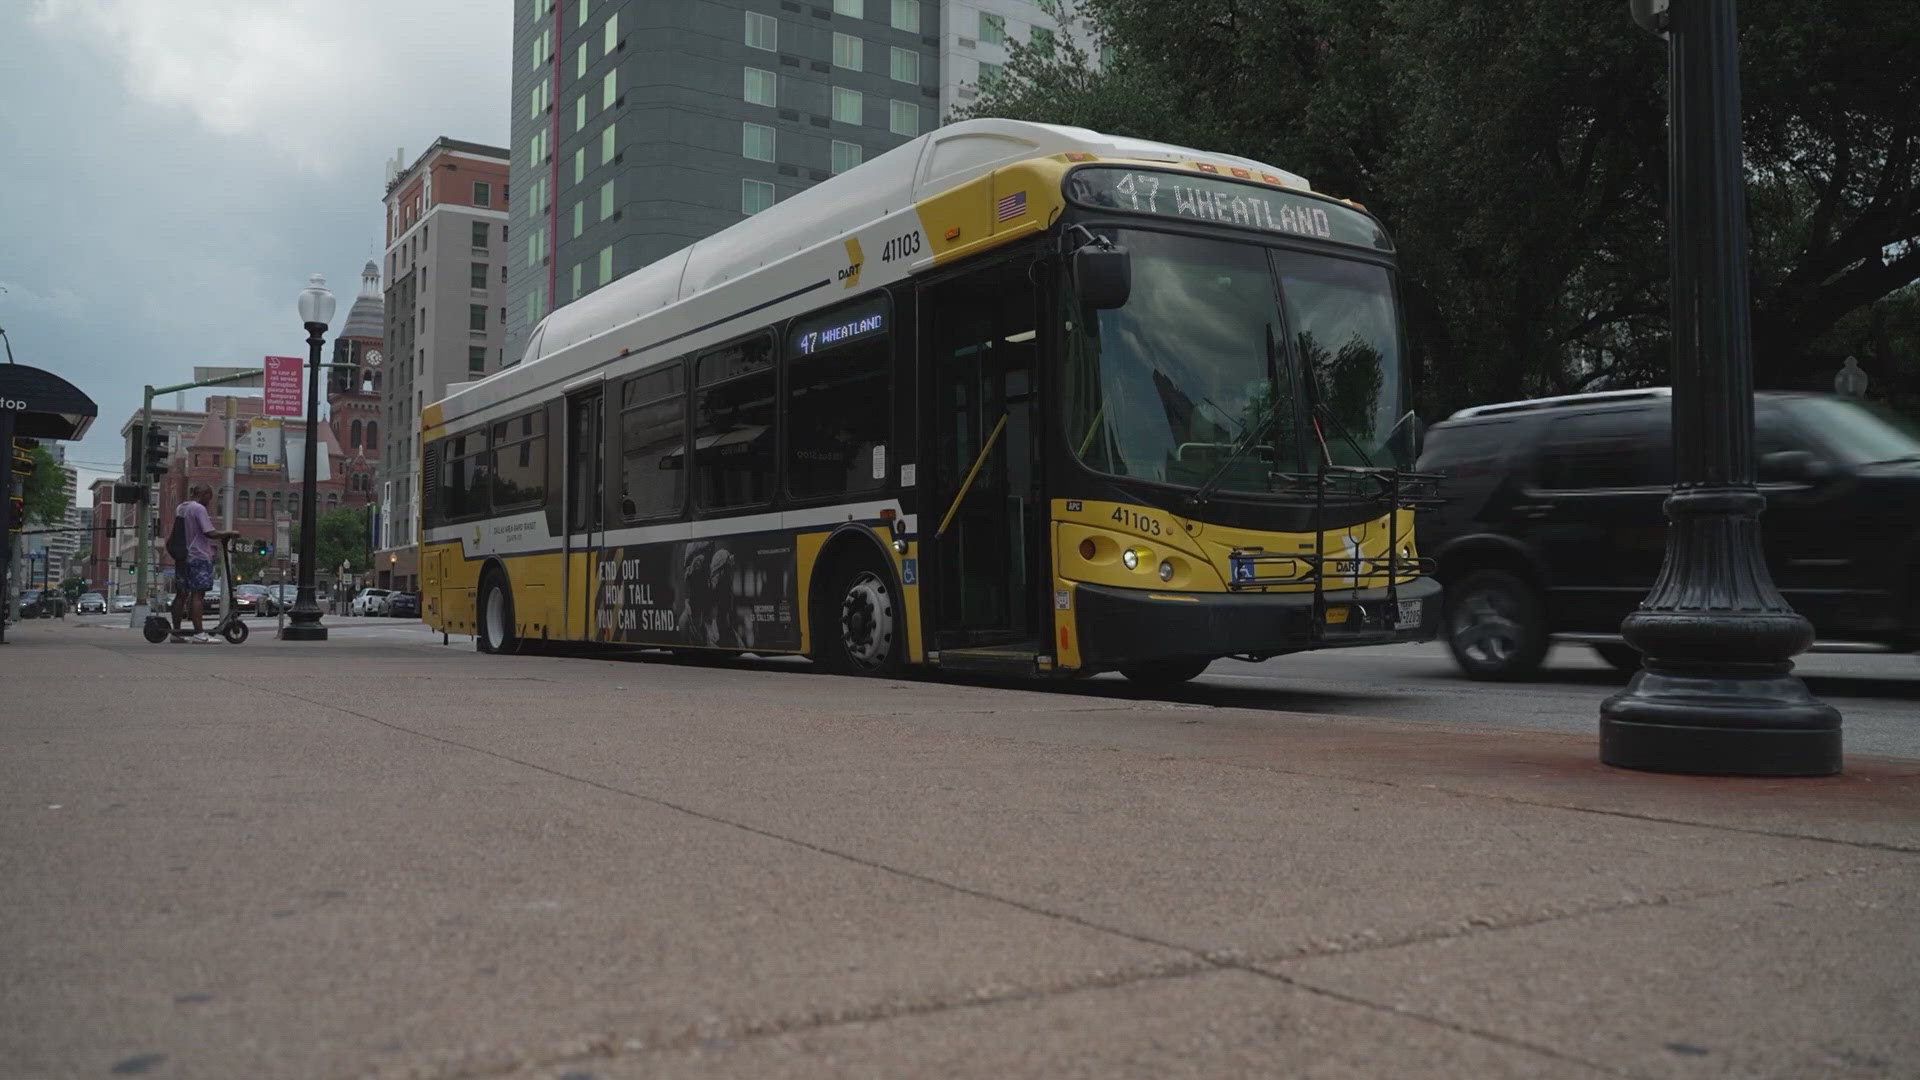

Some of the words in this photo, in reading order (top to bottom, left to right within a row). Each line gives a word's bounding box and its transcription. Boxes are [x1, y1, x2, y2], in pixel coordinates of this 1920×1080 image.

[1116, 173, 1160, 213] 47
[1173, 185, 1331, 238] WHEATLAND
[882, 230, 921, 263] 41103
[838, 263, 860, 280] DART
[800, 332, 817, 354] 47
[822, 315, 882, 344] WHEATLAND
[0, 397, 27, 410] top
[1111, 506, 1161, 536] 41103
[622, 559, 640, 580] OUT
[605, 584, 624, 605] HOW
[628, 583, 654, 605] TALL
[597, 608, 613, 629] YOU
[618, 608, 636, 630] CAN
[641, 608, 680, 631] STAND.
